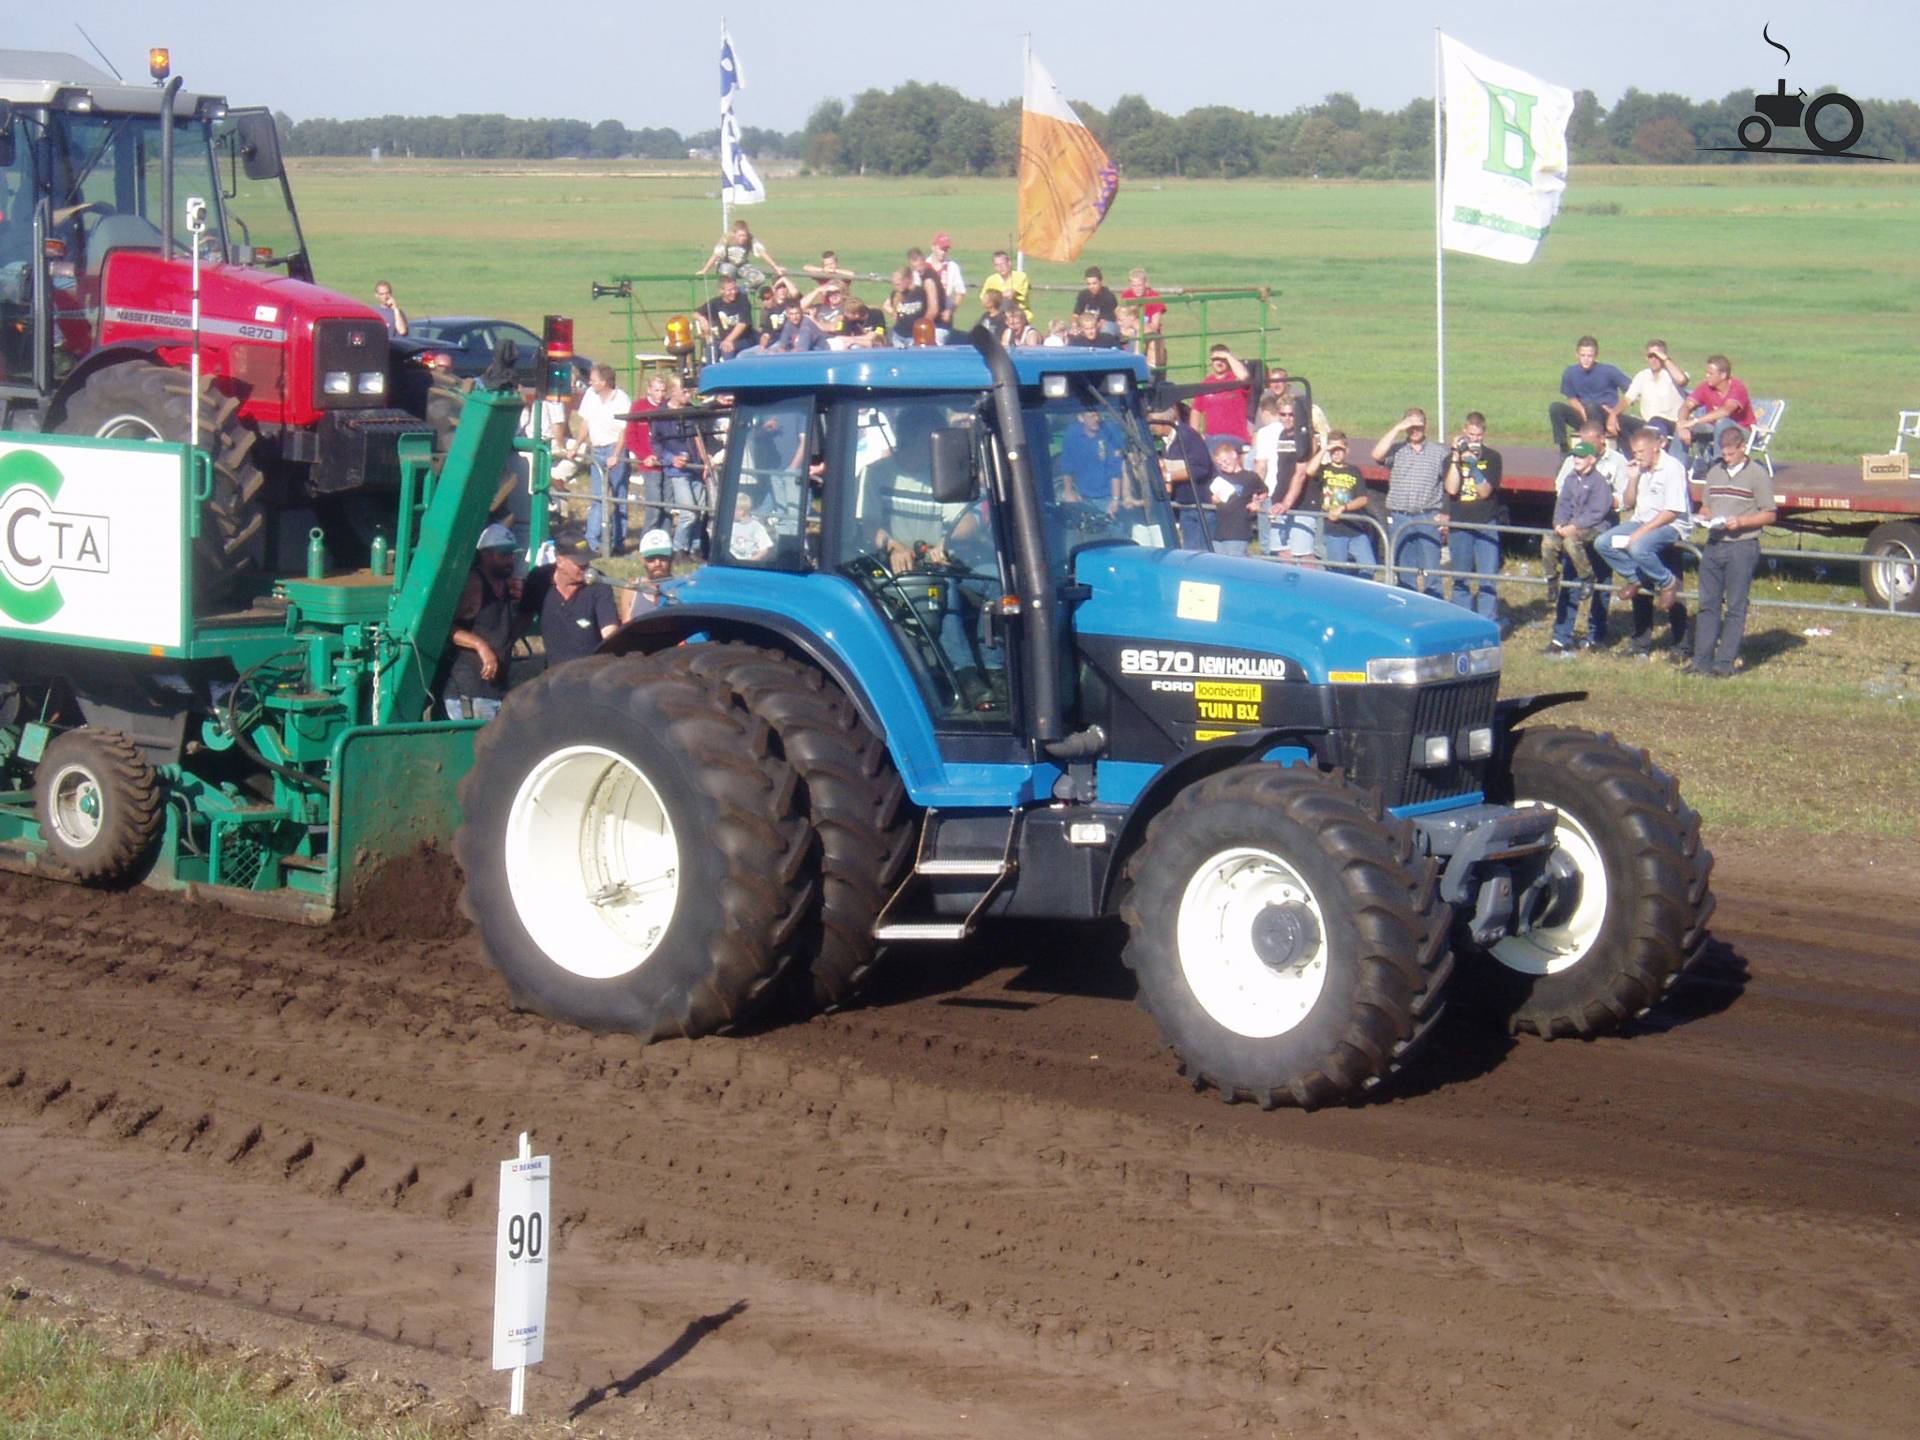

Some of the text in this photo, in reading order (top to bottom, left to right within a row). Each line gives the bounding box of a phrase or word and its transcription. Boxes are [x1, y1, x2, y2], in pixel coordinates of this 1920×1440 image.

[117, 310, 192, 328] MASSEY FERGUSON
[239, 326, 273, 340] 4270
[1121, 649, 1194, 673] 8670
[1151, 681, 1194, 692] FORD
[1198, 683, 1258, 699] loonbedrijf
[1198, 702, 1259, 721] TUIN B.V.
[508, 1211, 542, 1260] 90
